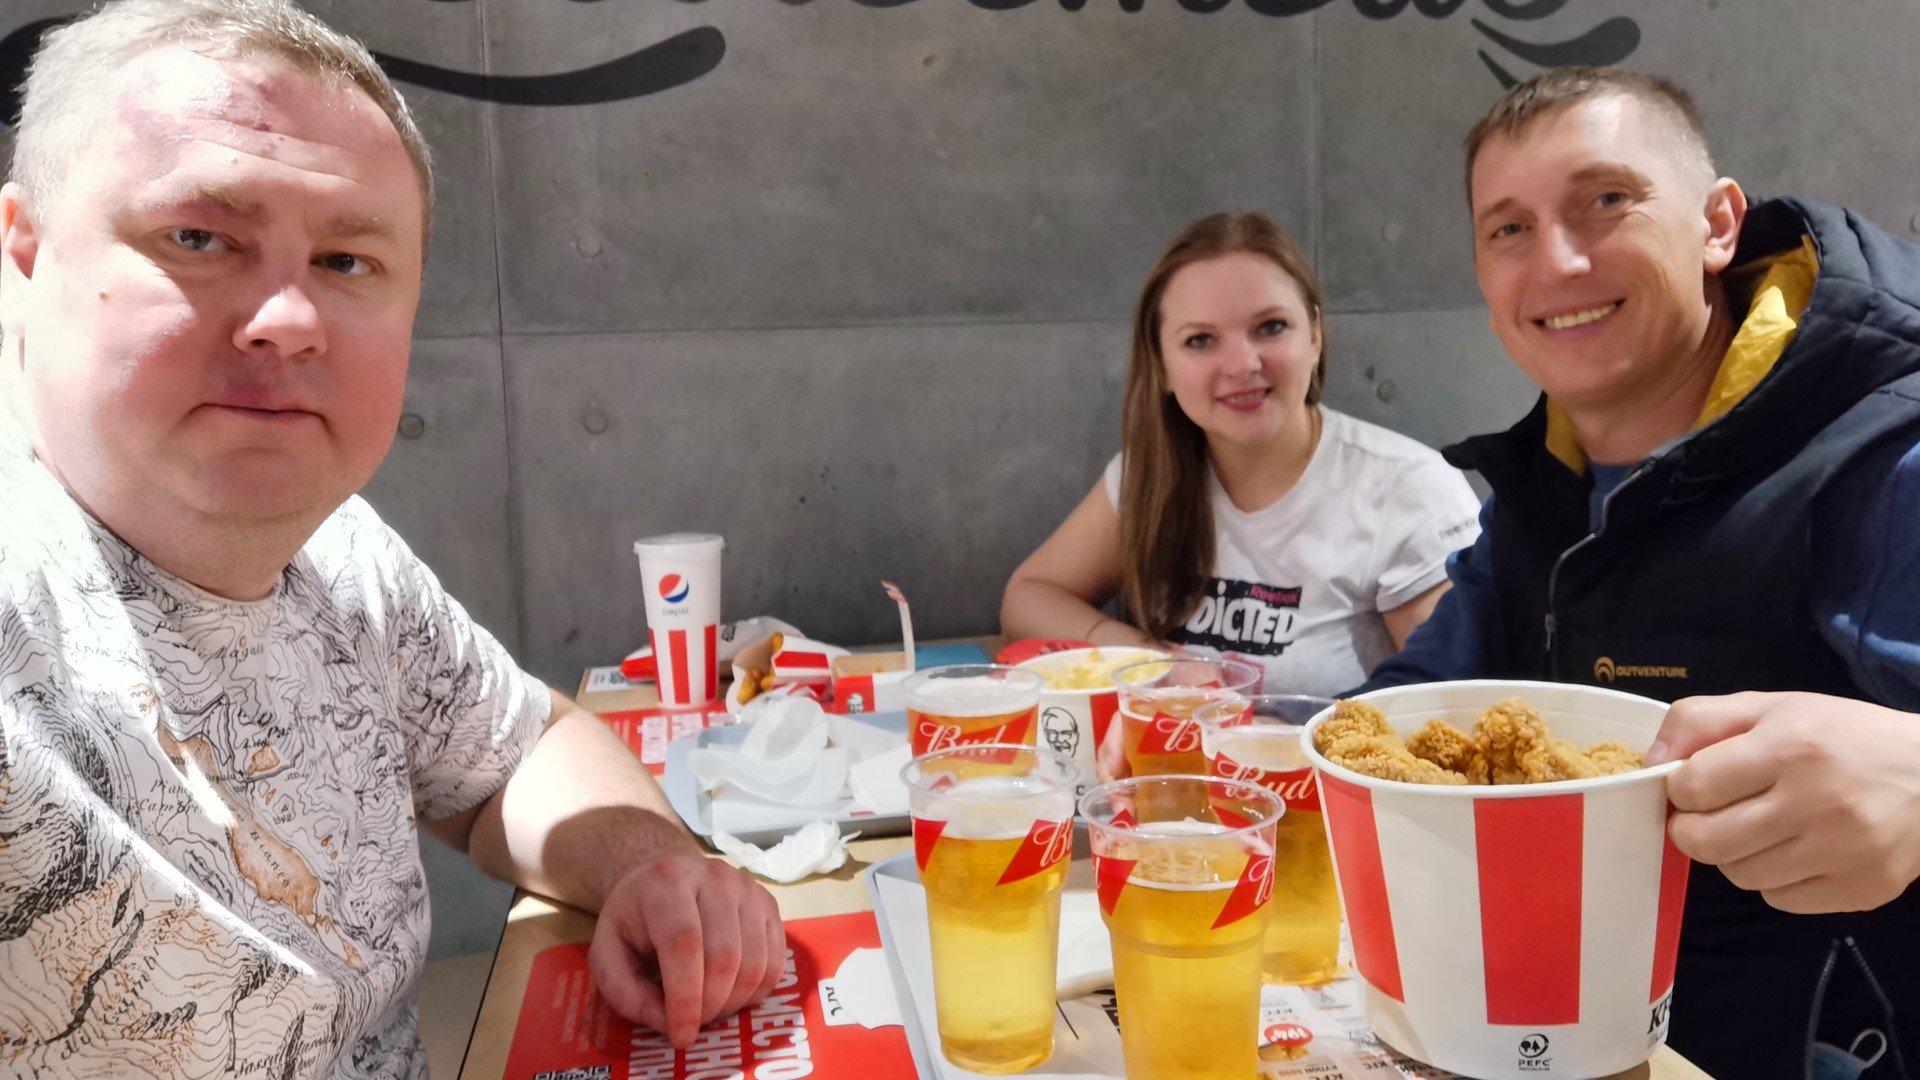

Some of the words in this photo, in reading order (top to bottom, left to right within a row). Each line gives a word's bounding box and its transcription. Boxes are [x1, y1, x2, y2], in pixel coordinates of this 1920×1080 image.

[919, 721, 1007, 754] Bud
[1217, 759, 1315, 800] Bud
[1518, 1059, 1550, 1067] PEFC
